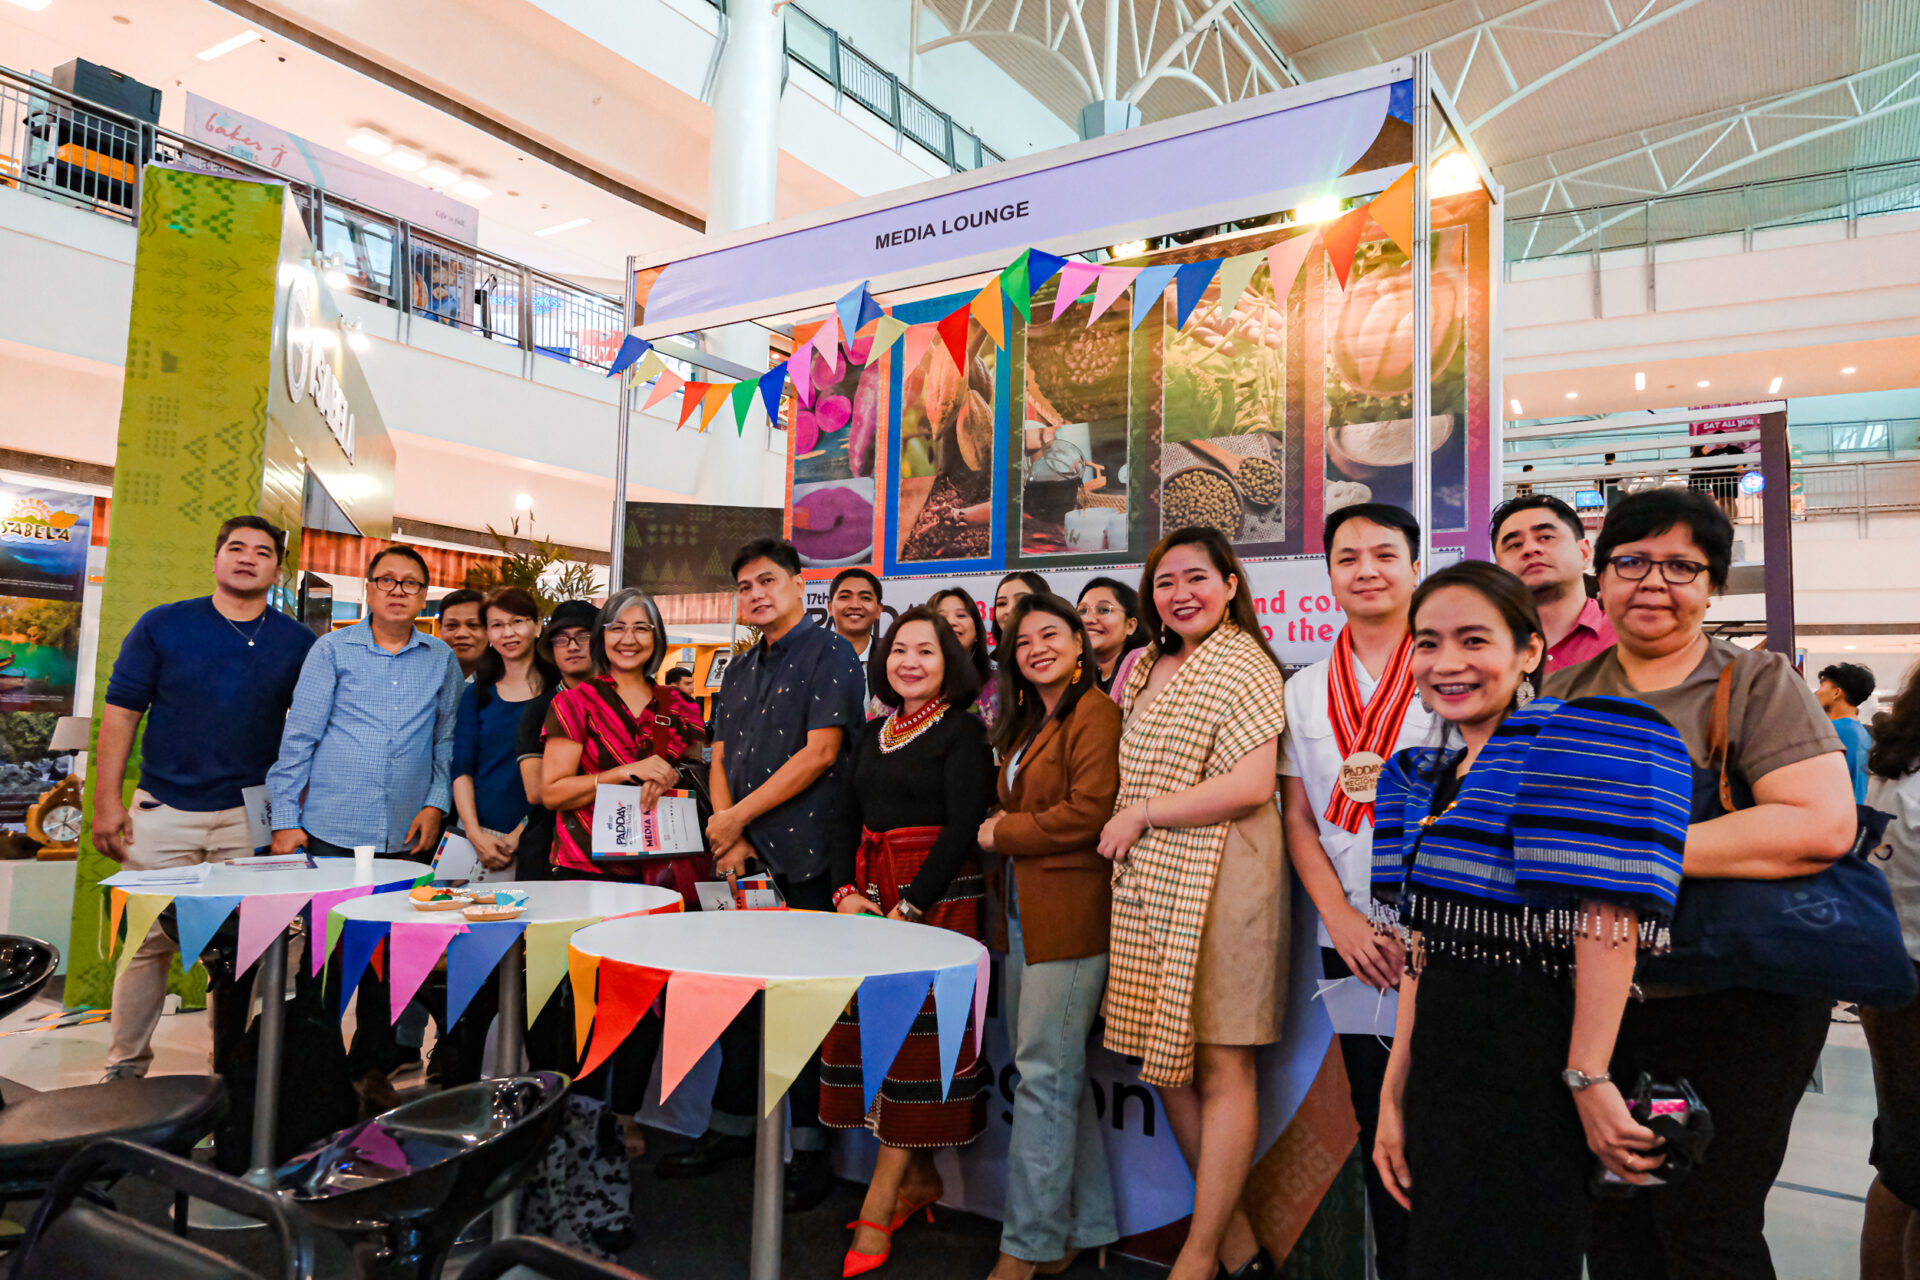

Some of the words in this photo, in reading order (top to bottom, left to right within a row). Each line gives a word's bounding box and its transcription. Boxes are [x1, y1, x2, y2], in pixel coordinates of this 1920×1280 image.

[875, 223, 936, 250] MEDIA
[942, 200, 1030, 235] LOUNGE
[806, 592, 829, 605] 17th
[1253, 589, 1286, 614] nd
[1288, 617, 1334, 642] the
[615, 801, 627, 846] PADDAY
[643, 818, 654, 847] MEDIA
